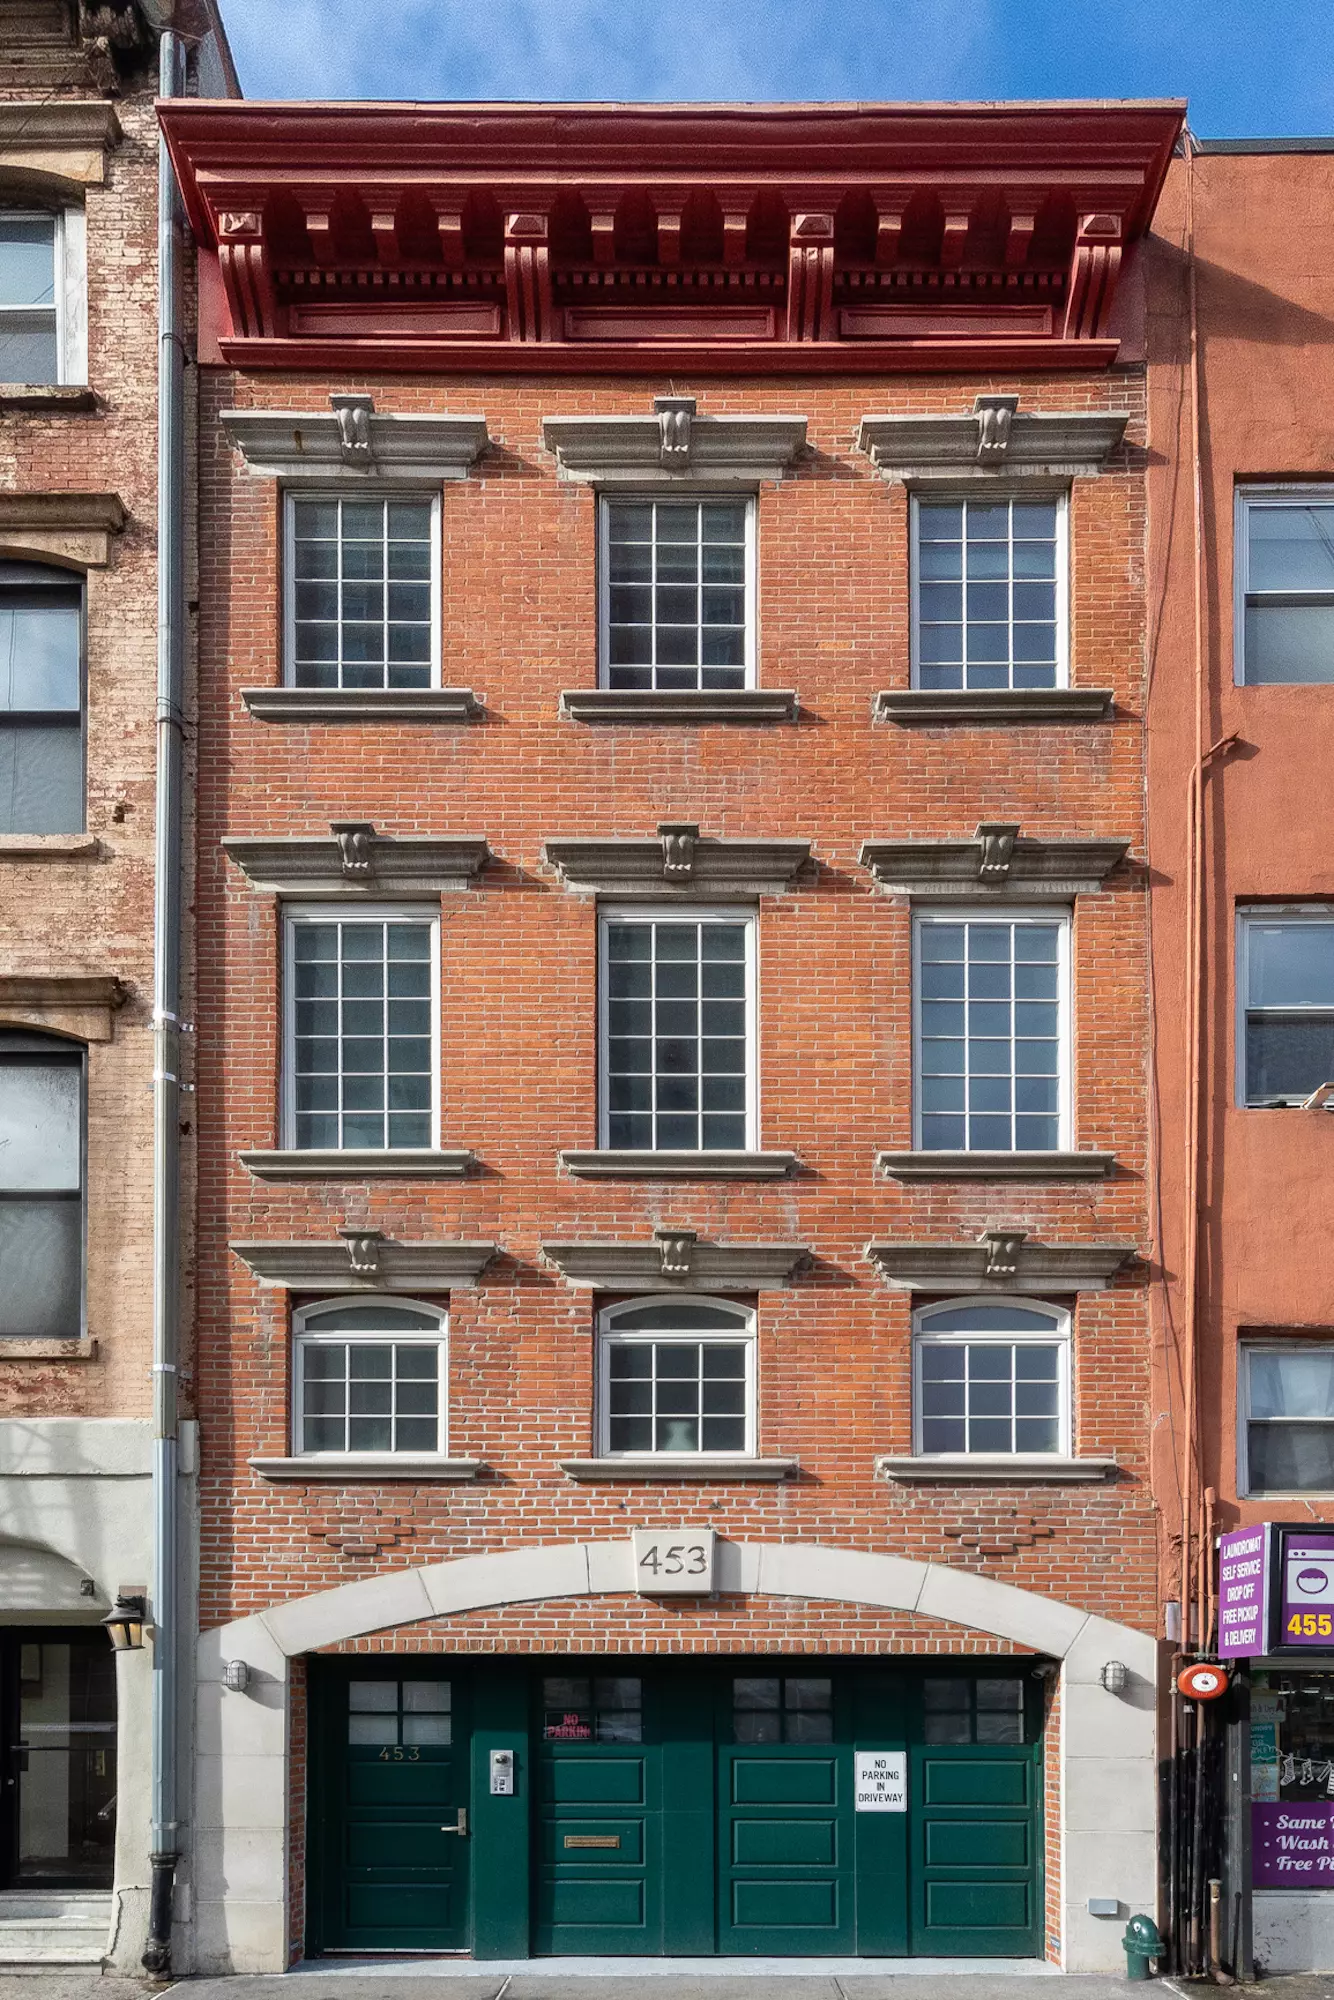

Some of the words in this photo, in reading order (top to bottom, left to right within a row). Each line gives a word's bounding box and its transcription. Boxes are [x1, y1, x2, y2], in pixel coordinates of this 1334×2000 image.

[1223, 1535, 1262, 1560] LAUNDROMAT
[639, 1545, 708, 1575] 453
[1222, 1564, 1236, 1581] SELF
[1237, 1559, 1261, 1578] SERVICE
[1227, 1586, 1242, 1602] DROP
[1243, 1583, 1255, 1599] OFF
[1223, 1608, 1237, 1624] FREE
[1238, 1605, 1259, 1622] PICKUP
[1287, 1613, 1333, 1636] 455
[1224, 1632, 1230, 1647] &
[1230, 1628, 1256, 1646] DELIVERY
[563, 1713, 579, 1725] NO
[547, 1725, 591, 1738] PARKIN
[379, 1746, 420, 1761] 453
[875, 1759, 886, 1768] NO
[862, 1771, 899, 1779] PARKING
[877, 1782, 885, 1790] IN
[858, 1793, 903, 1802] DRIVEWAY
[1276, 1814, 1327, 1829] Same
[1276, 1835, 1329, 1850] Wash
[1276, 1856, 1313, 1871] Free
